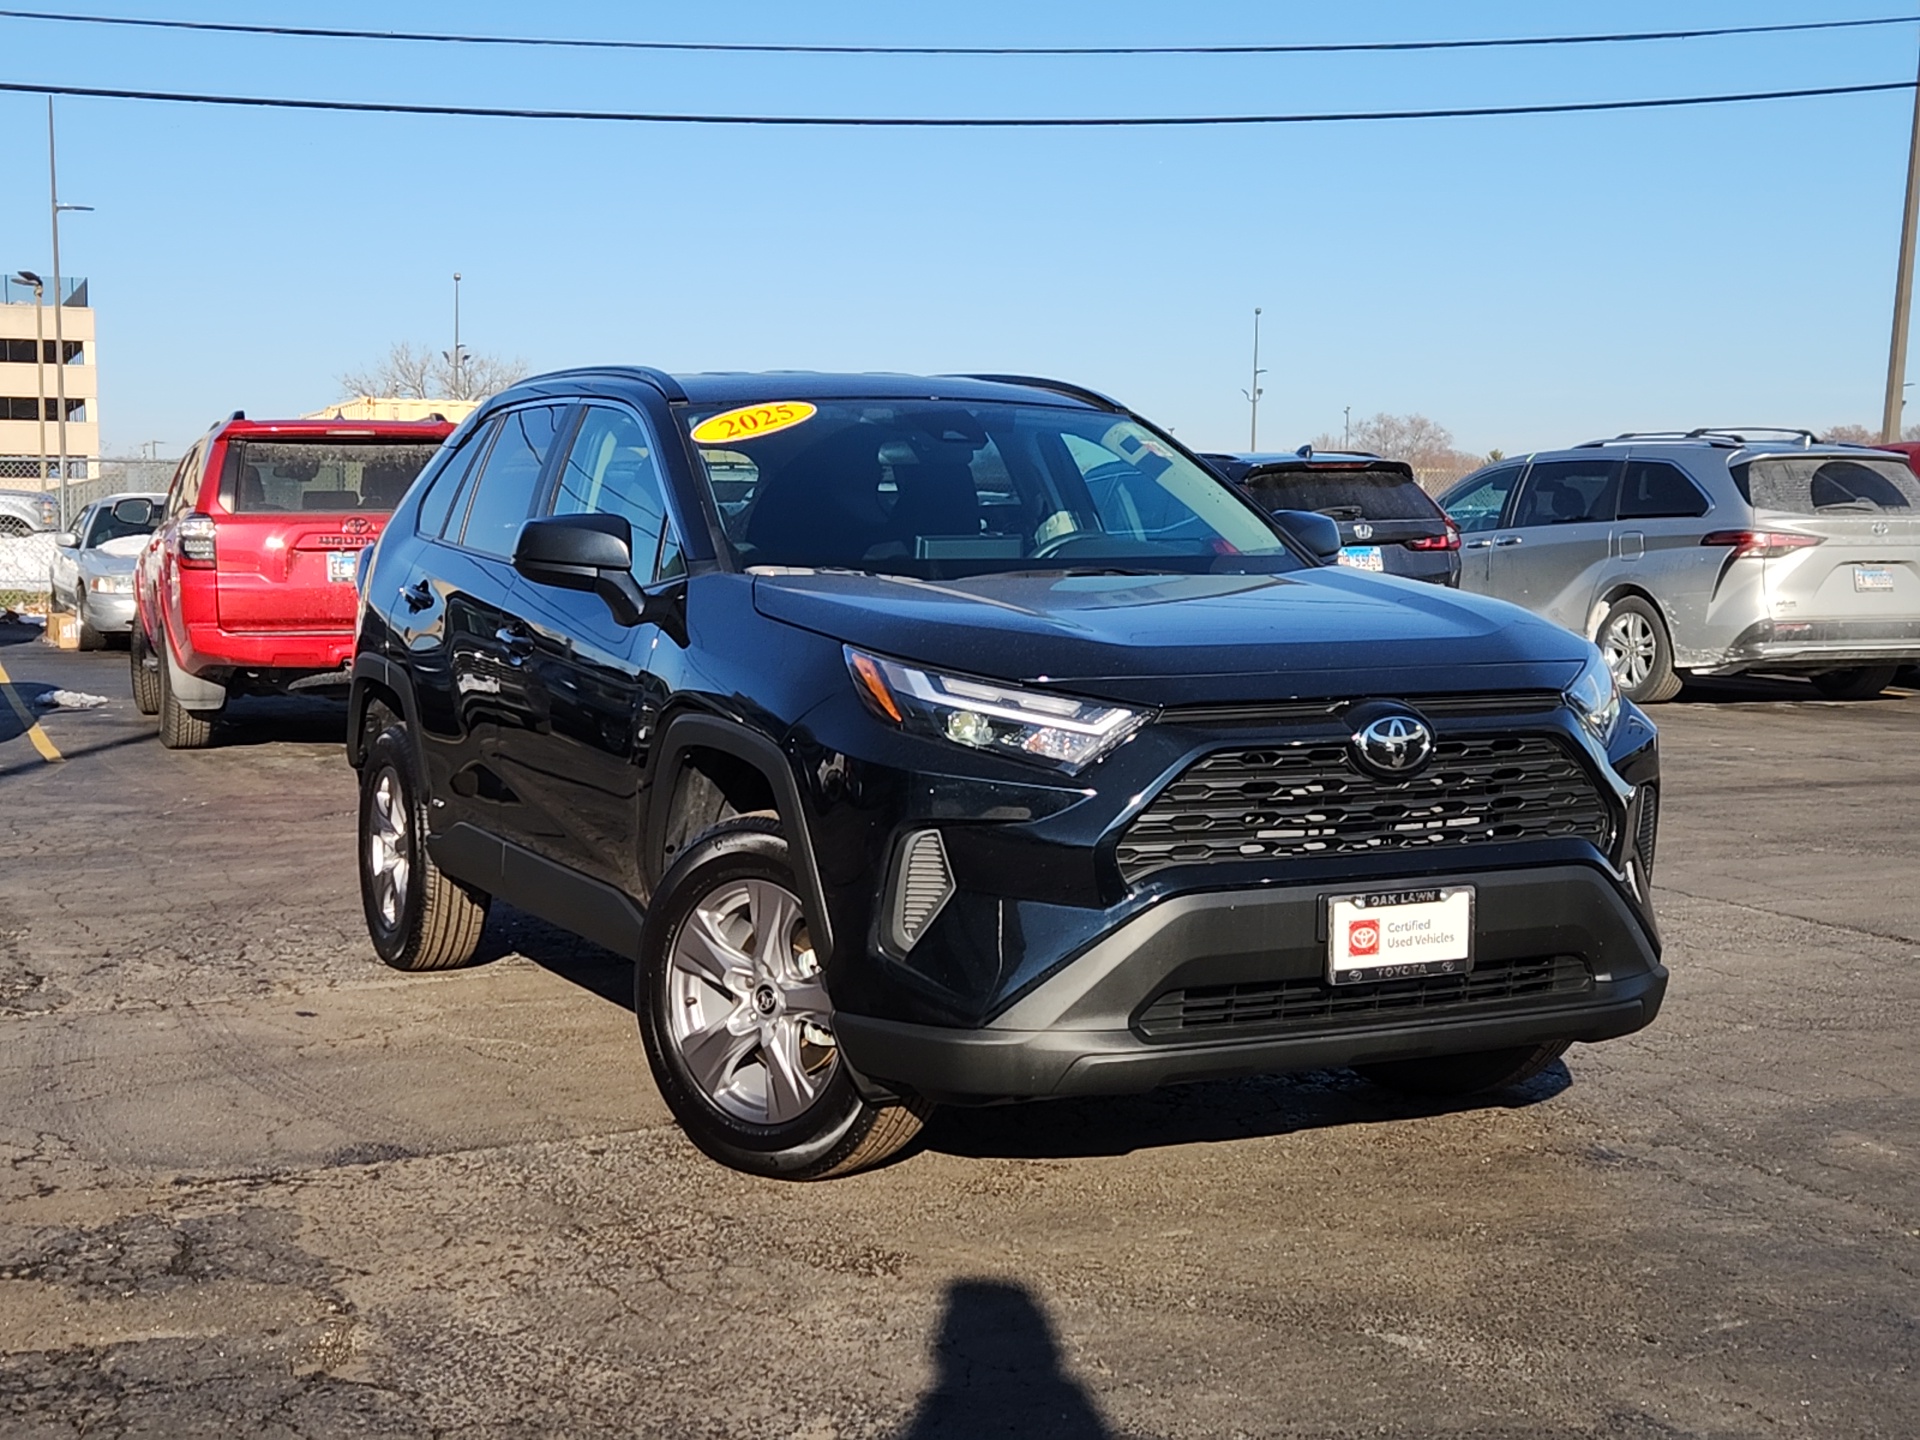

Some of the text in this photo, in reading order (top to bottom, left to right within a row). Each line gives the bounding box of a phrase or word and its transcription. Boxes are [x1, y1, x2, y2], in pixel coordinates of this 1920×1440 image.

[718, 404, 795, 438] 2025
[1370, 891, 1435, 906] OAK LAWN
[1387, 919, 1431, 933] Certified
[1387, 932, 1455, 948] Used Vehicles
[1376, 964, 1428, 978] TOYOTA
